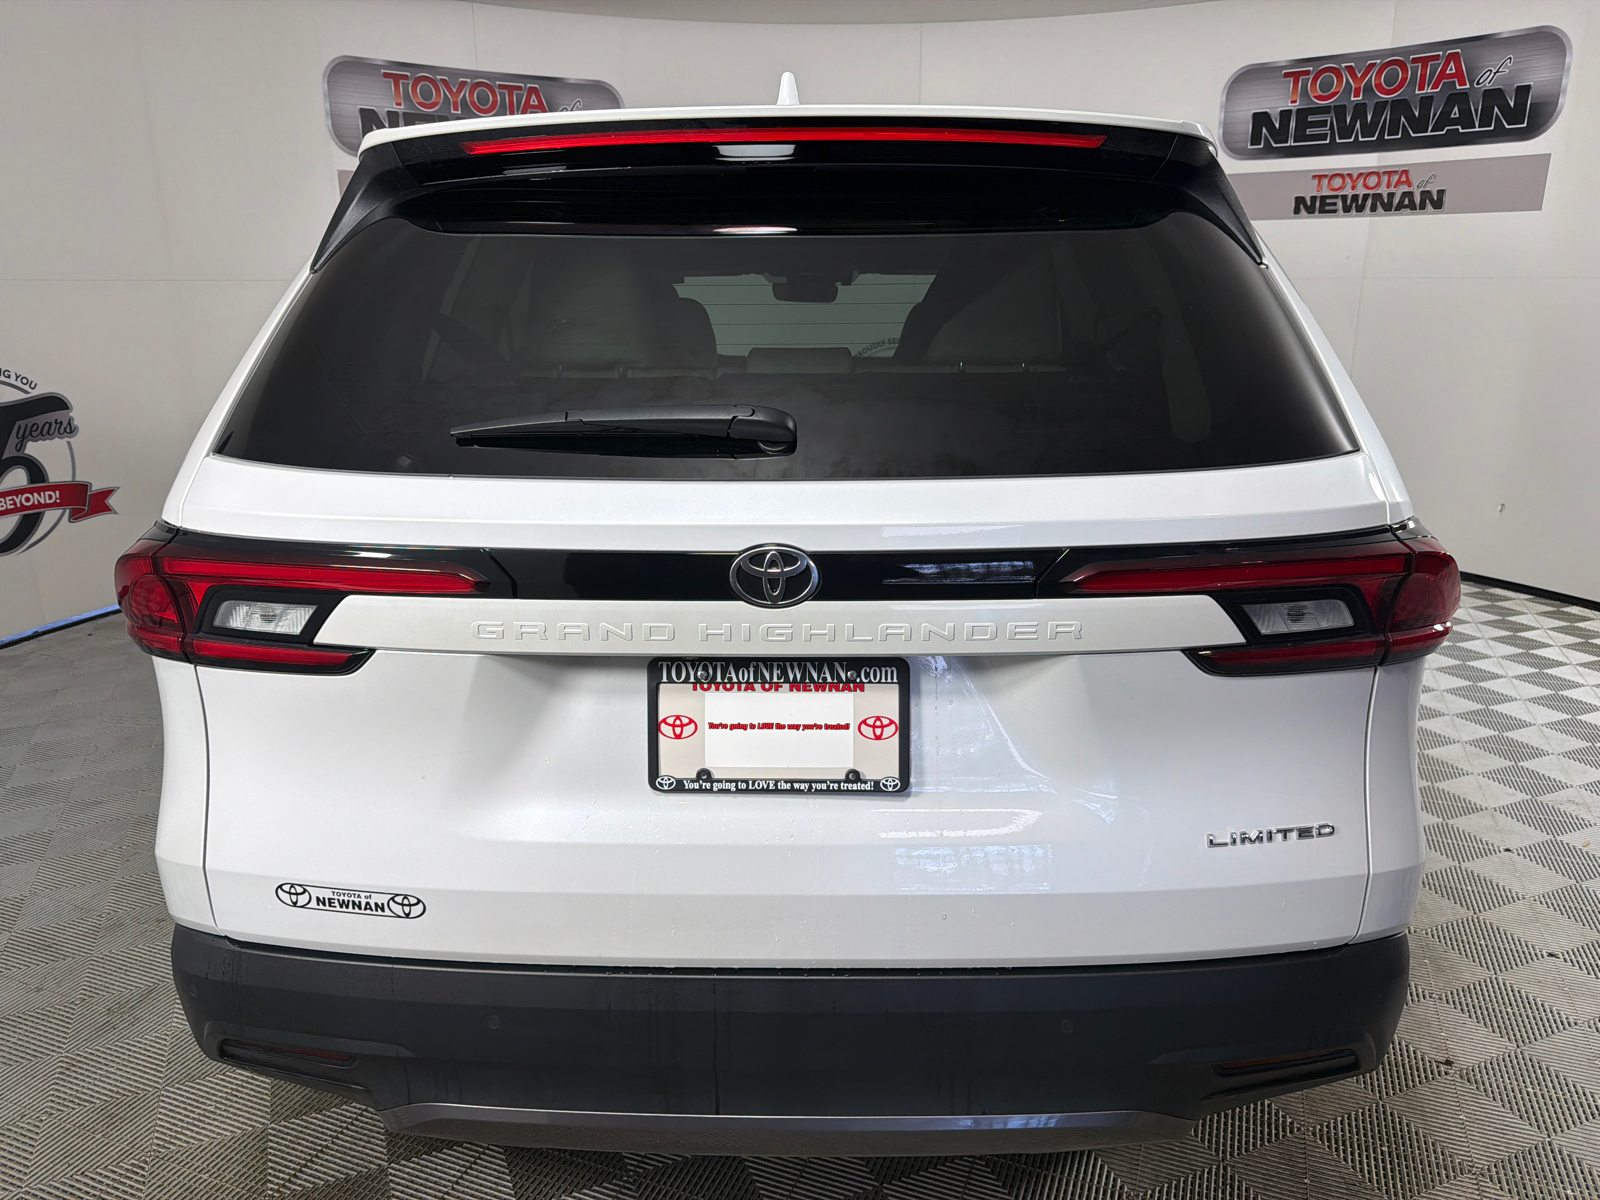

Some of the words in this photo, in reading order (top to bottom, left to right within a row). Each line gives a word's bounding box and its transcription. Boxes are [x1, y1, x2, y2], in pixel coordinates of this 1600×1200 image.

[1283, 50, 1469, 105] TOYOTA
[1474, 56, 1513, 87] of
[381, 69, 549, 117] TOYOTA
[1248, 83, 1533, 148] NEWNAN
[1311, 169, 1413, 194] TOYOTA
[1416, 173, 1436, 190] of
[1293, 189, 1446, 216] NEWNAN
[14, 372, 38, 390] YOU
[15, 417, 76, 453] years
[0, 490, 60, 510] BEYOND!
[471, 621, 676, 642] GRAND
[699, 620, 1084, 643] HIGHLANDER
[692, 682, 756, 692] TOYOTA
[760, 682, 783, 692] OF
[789, 682, 865, 692] NEWNAN
[787, 723, 801, 731] way
[712, 780, 737, 792] going
[738, 780, 747, 790] to
[748, 780, 775, 790] LOVE
[777, 780, 791, 790] the
[793, 783, 810, 792] way
[840, 781, 874, 791] treated!
[1207, 822, 1335, 848] LIMITED
[316, 896, 385, 913] NEWNAN
[331, 891, 362, 900] TOYOTA
